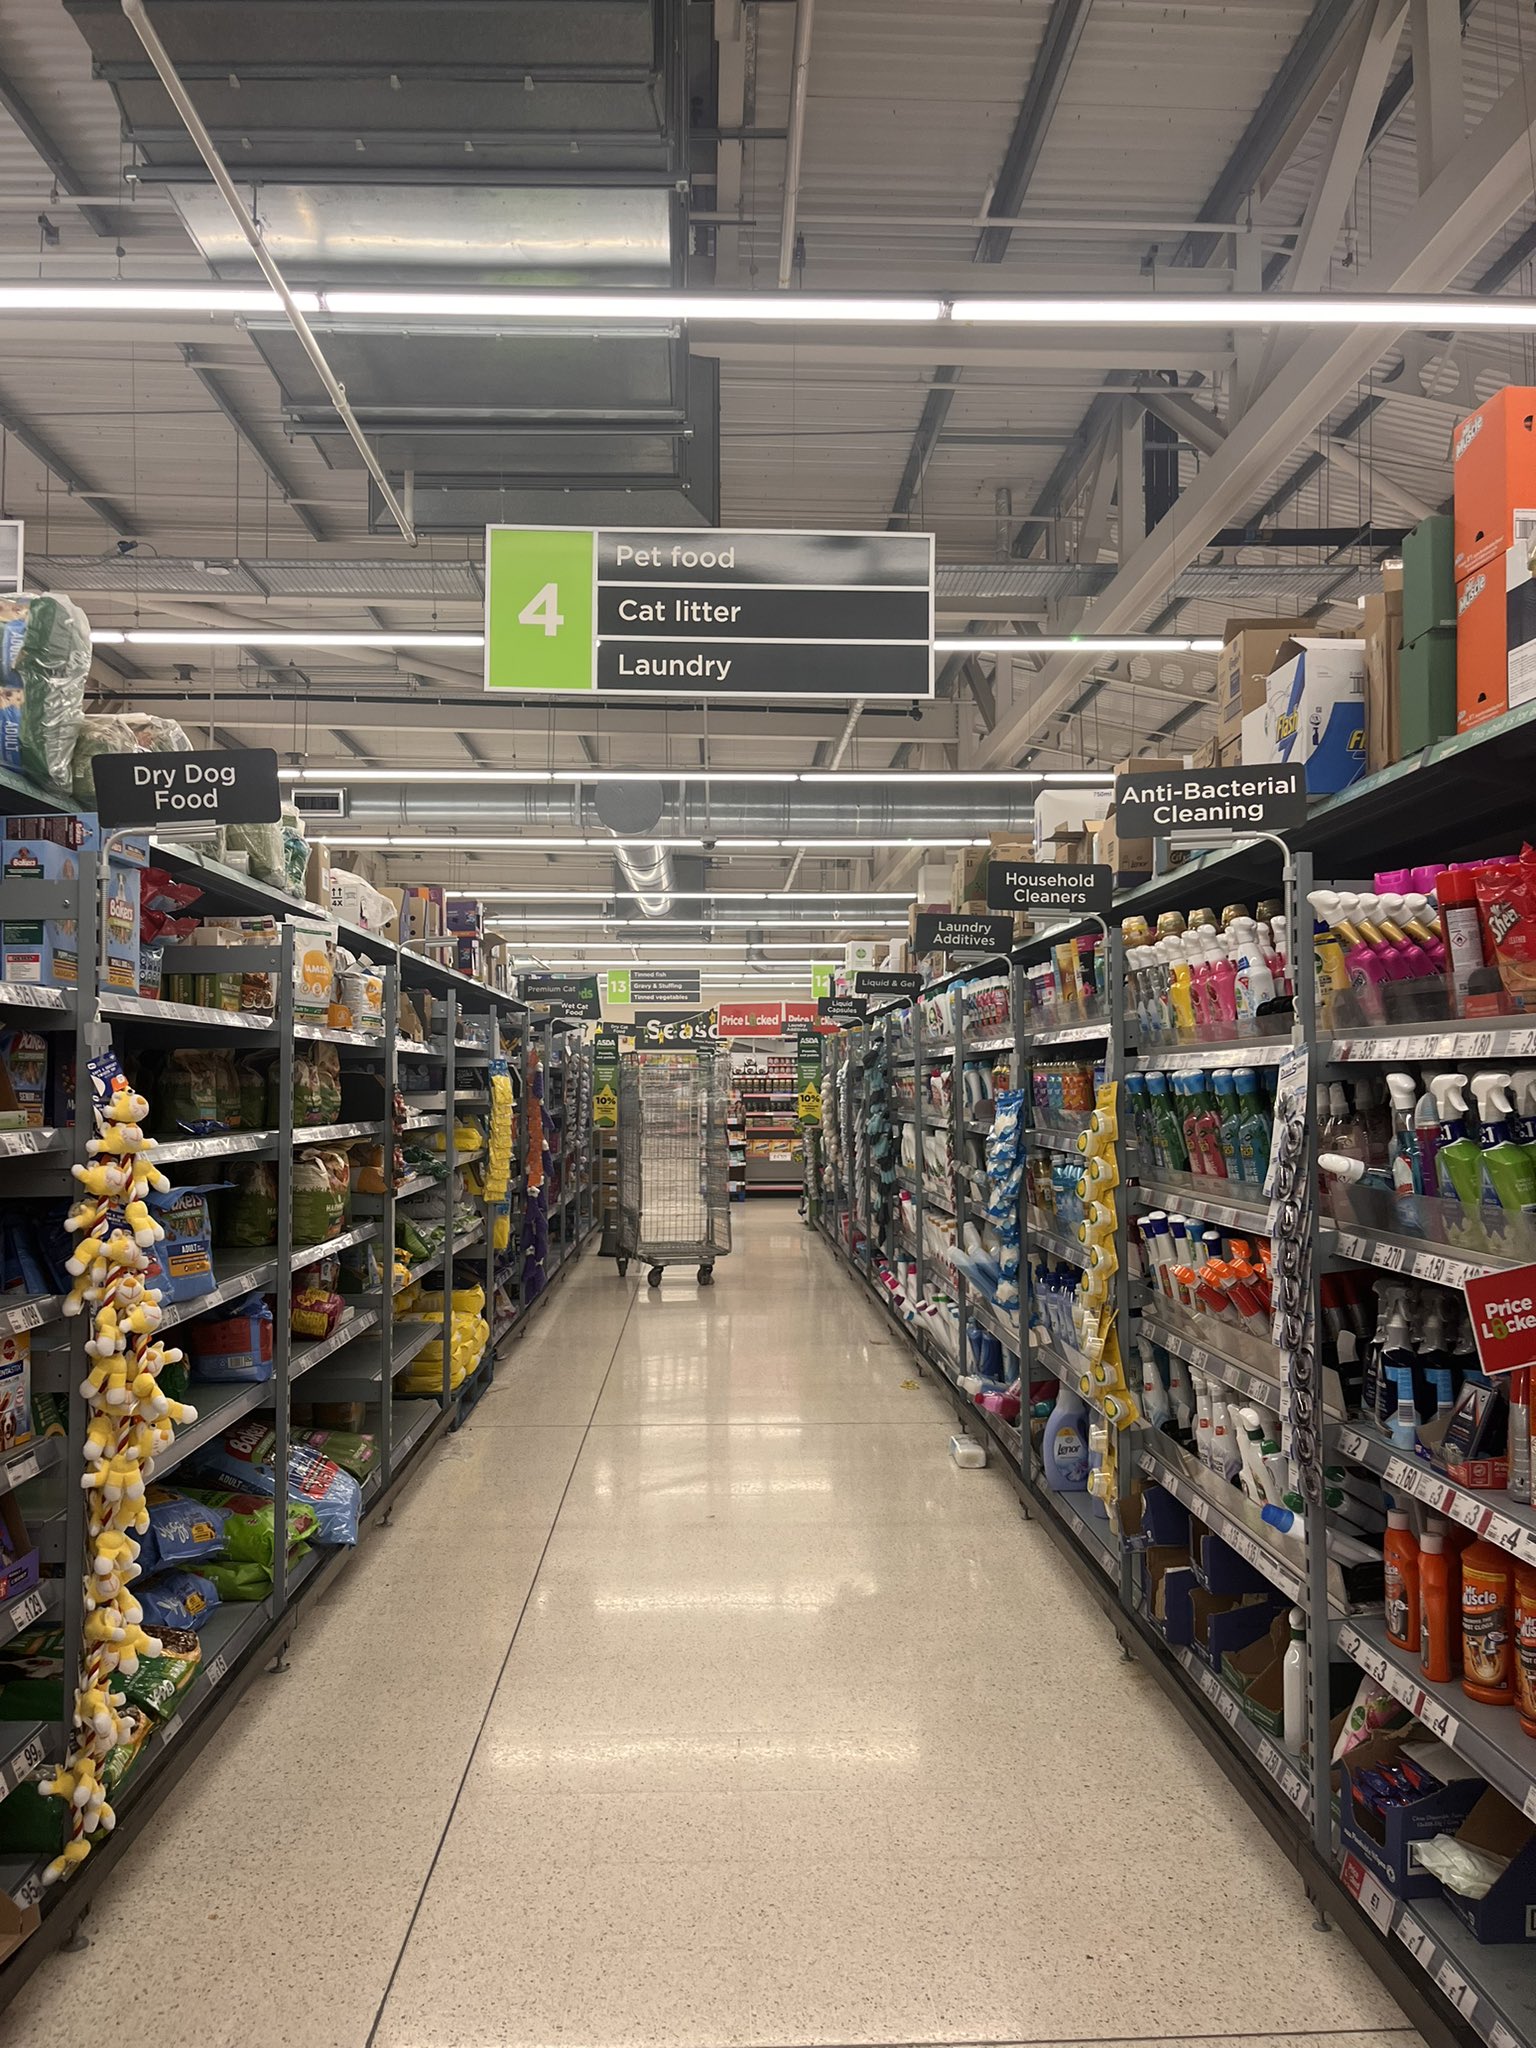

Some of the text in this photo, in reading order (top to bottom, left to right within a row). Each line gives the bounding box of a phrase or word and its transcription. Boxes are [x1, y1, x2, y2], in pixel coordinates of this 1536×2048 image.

[616, 545, 735, 568] Pet food
[518, 583, 564, 636] 4
[618, 599, 741, 623] Cat litter
[618, 654, 731, 680] Laundry
[133, 764, 236, 788] Dry Dog
[154, 788, 219, 810] Food
[1121, 775, 1296, 805] Anti-Bacterial
[1153, 802, 1264, 824] Cleaning
[1005, 872, 1095, 888] Household
[1013, 889, 1087, 904] Cleaners
[938, 921, 992, 935] Laundry
[933, 933, 996, 946] Additives
[610, 981, 627, 993] 13
[659, 982, 682, 990] Stuffing
[862, 979, 889, 988] Liquid
[721, 1015, 743, 1026] Price
[827, 1006, 857, 1015] Capsules
[595, 1096, 616, 1105] 10%
[800, 1094, 820, 1103] 10%
[1485, 1297, 1533, 1320] Price
[1057, 1442, 1081, 1455] Lenor
[218, 1473, 243, 1490] ADULT
[1429, 1485, 1443, 1506] £3
[1463, 1504, 1480, 1526] £3
[1499, 1528, 1521, 1551] £4
[1465, 1585, 1476, 1596] Mr
[1348, 1637, 1360, 1659] £2
[1373, 1661, 1387, 1682] £3
[1433, 1714, 1449, 1737] £4
[1408, 1935, 1425, 1955] £1
[1449, 1985, 1467, 2007] £1
